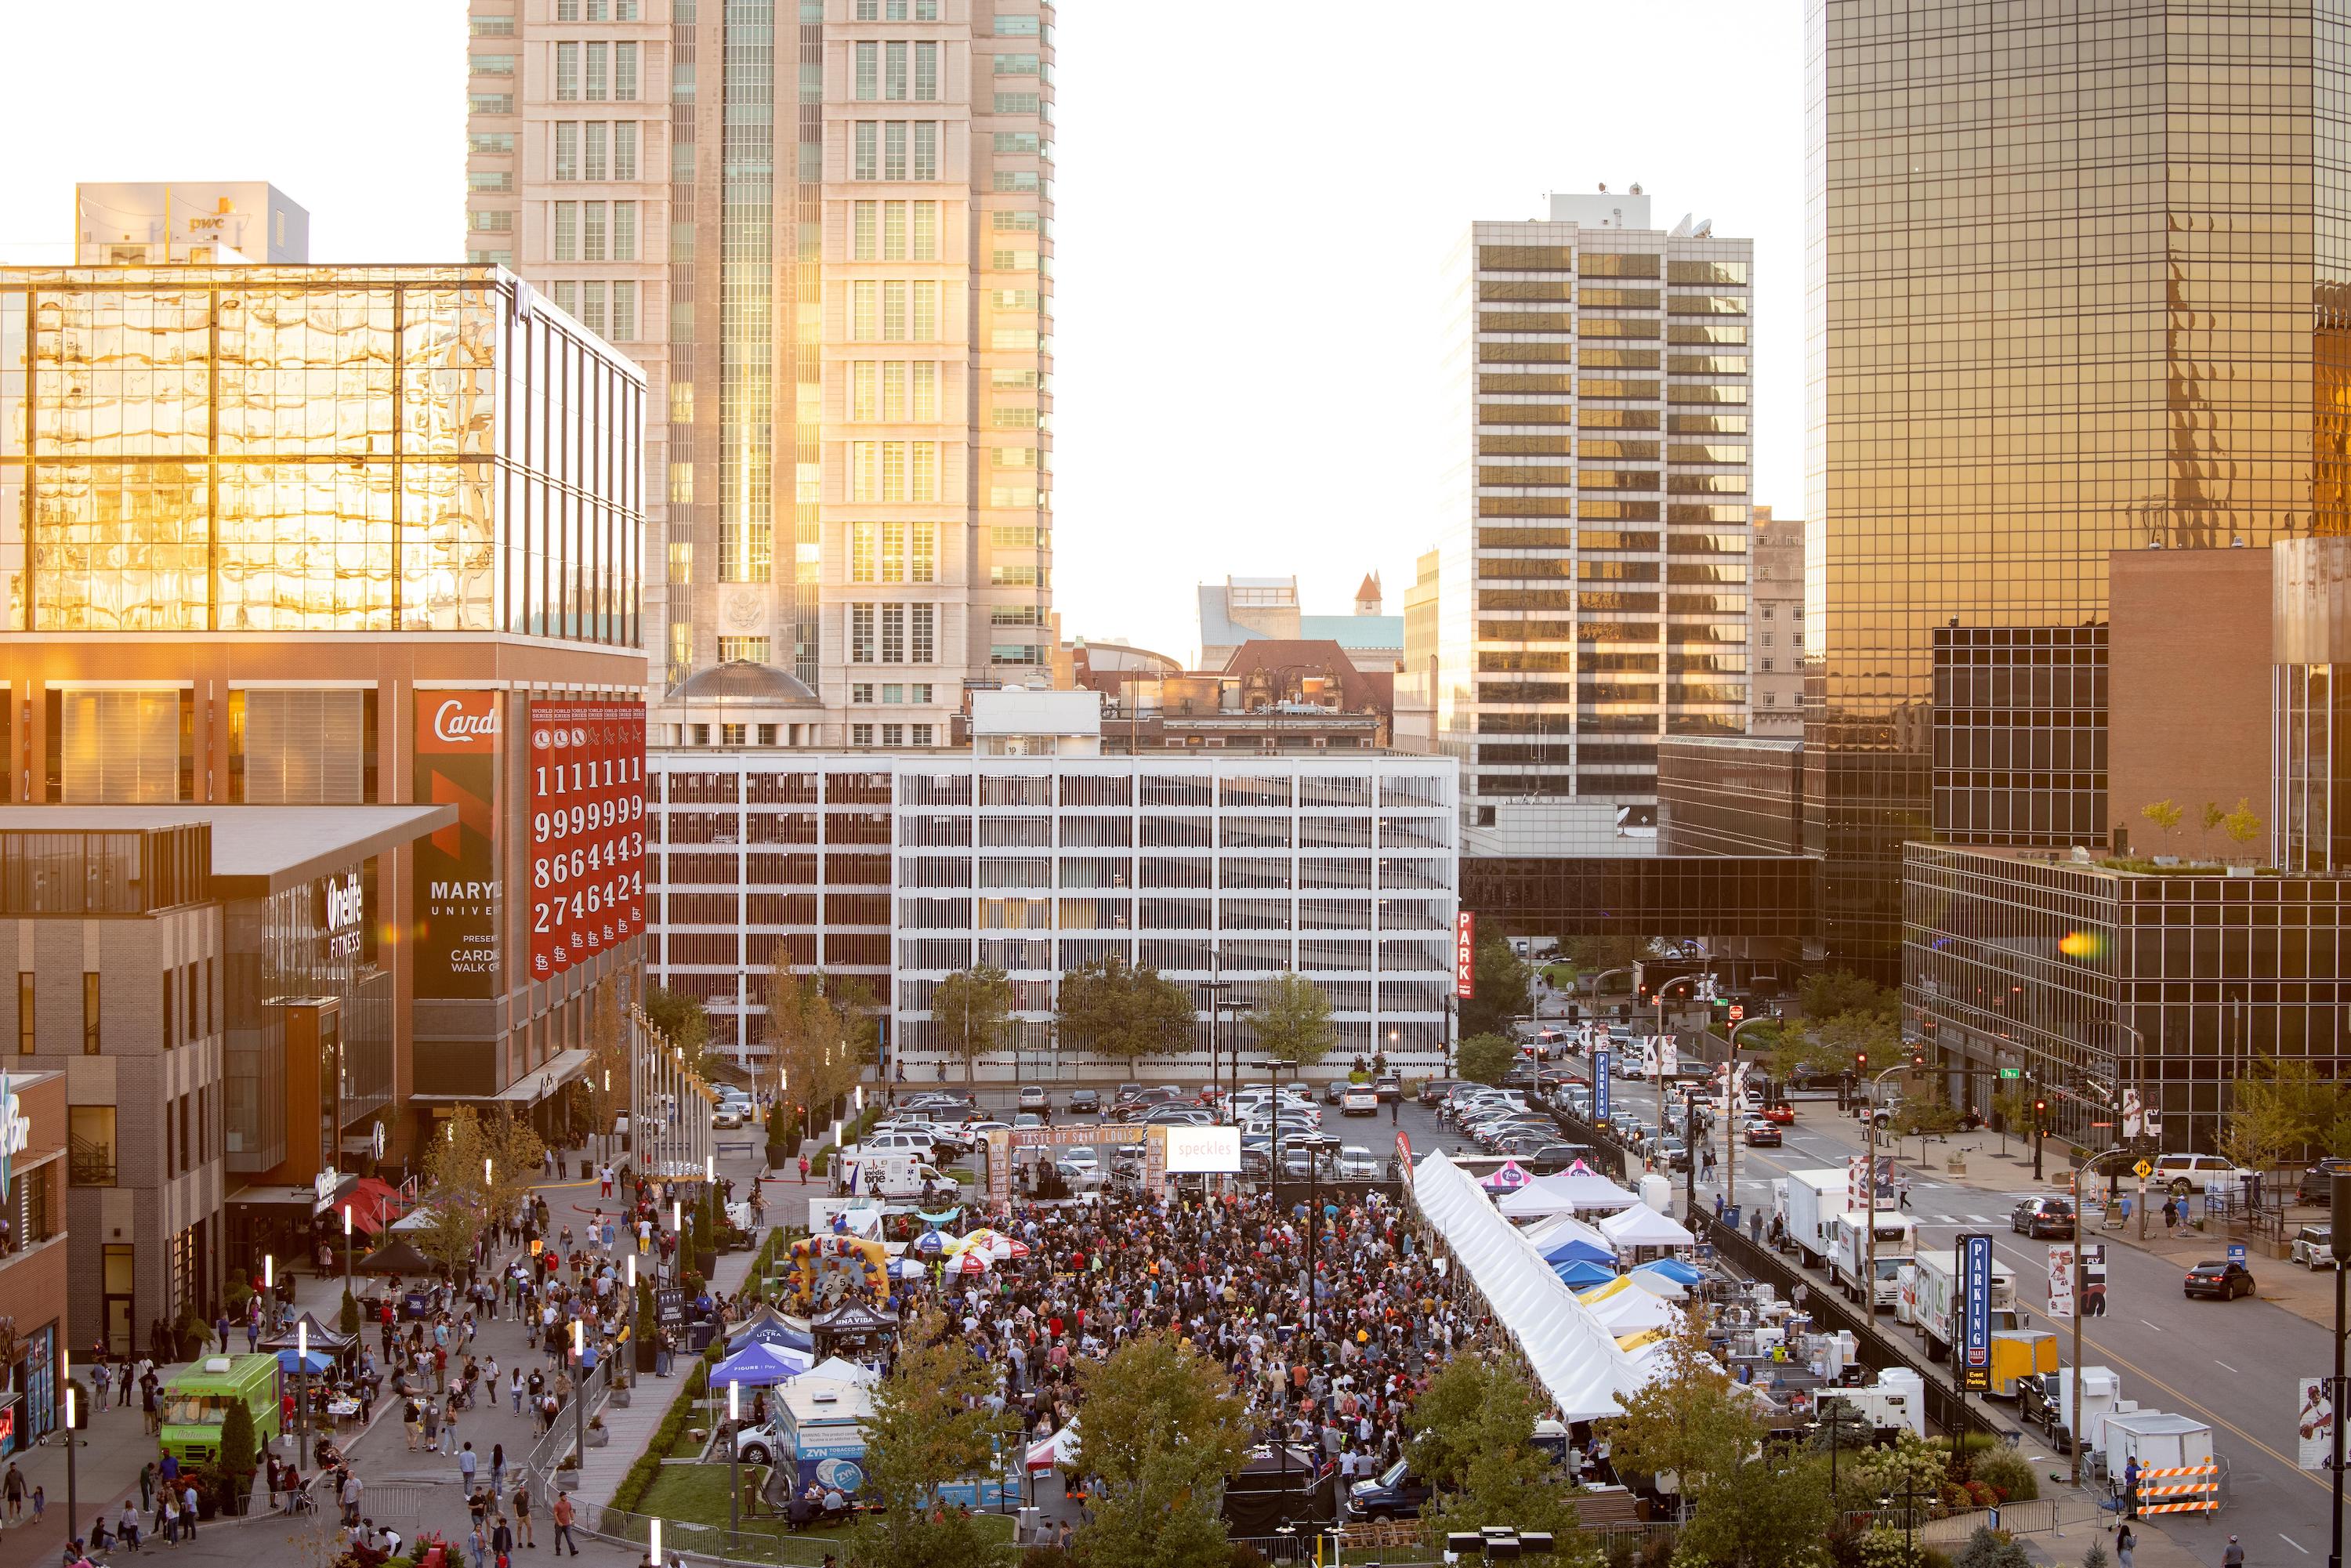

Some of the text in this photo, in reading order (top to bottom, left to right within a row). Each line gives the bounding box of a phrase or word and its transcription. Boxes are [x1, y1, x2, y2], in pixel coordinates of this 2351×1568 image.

[189, 218, 225, 232] pwc
[331, 931, 360, 959] FITNESS
[1459, 913, 1470, 980] PARK
[451, 963, 485, 972] WALK
[8, 1094, 30, 1155] Bar
[1022, 1130, 1134, 1143] TASTE OF SAINT LOUIS
[1150, 1138, 1164, 1146] NEW
[1179, 1141, 1231, 1157] speckles
[992, 1161, 1006, 1170] NEW
[1150, 1155, 1164, 1164] NEW
[1973, 1244, 1982, 1345] PARKING
[836, 1467, 857, 1482] ZYN
